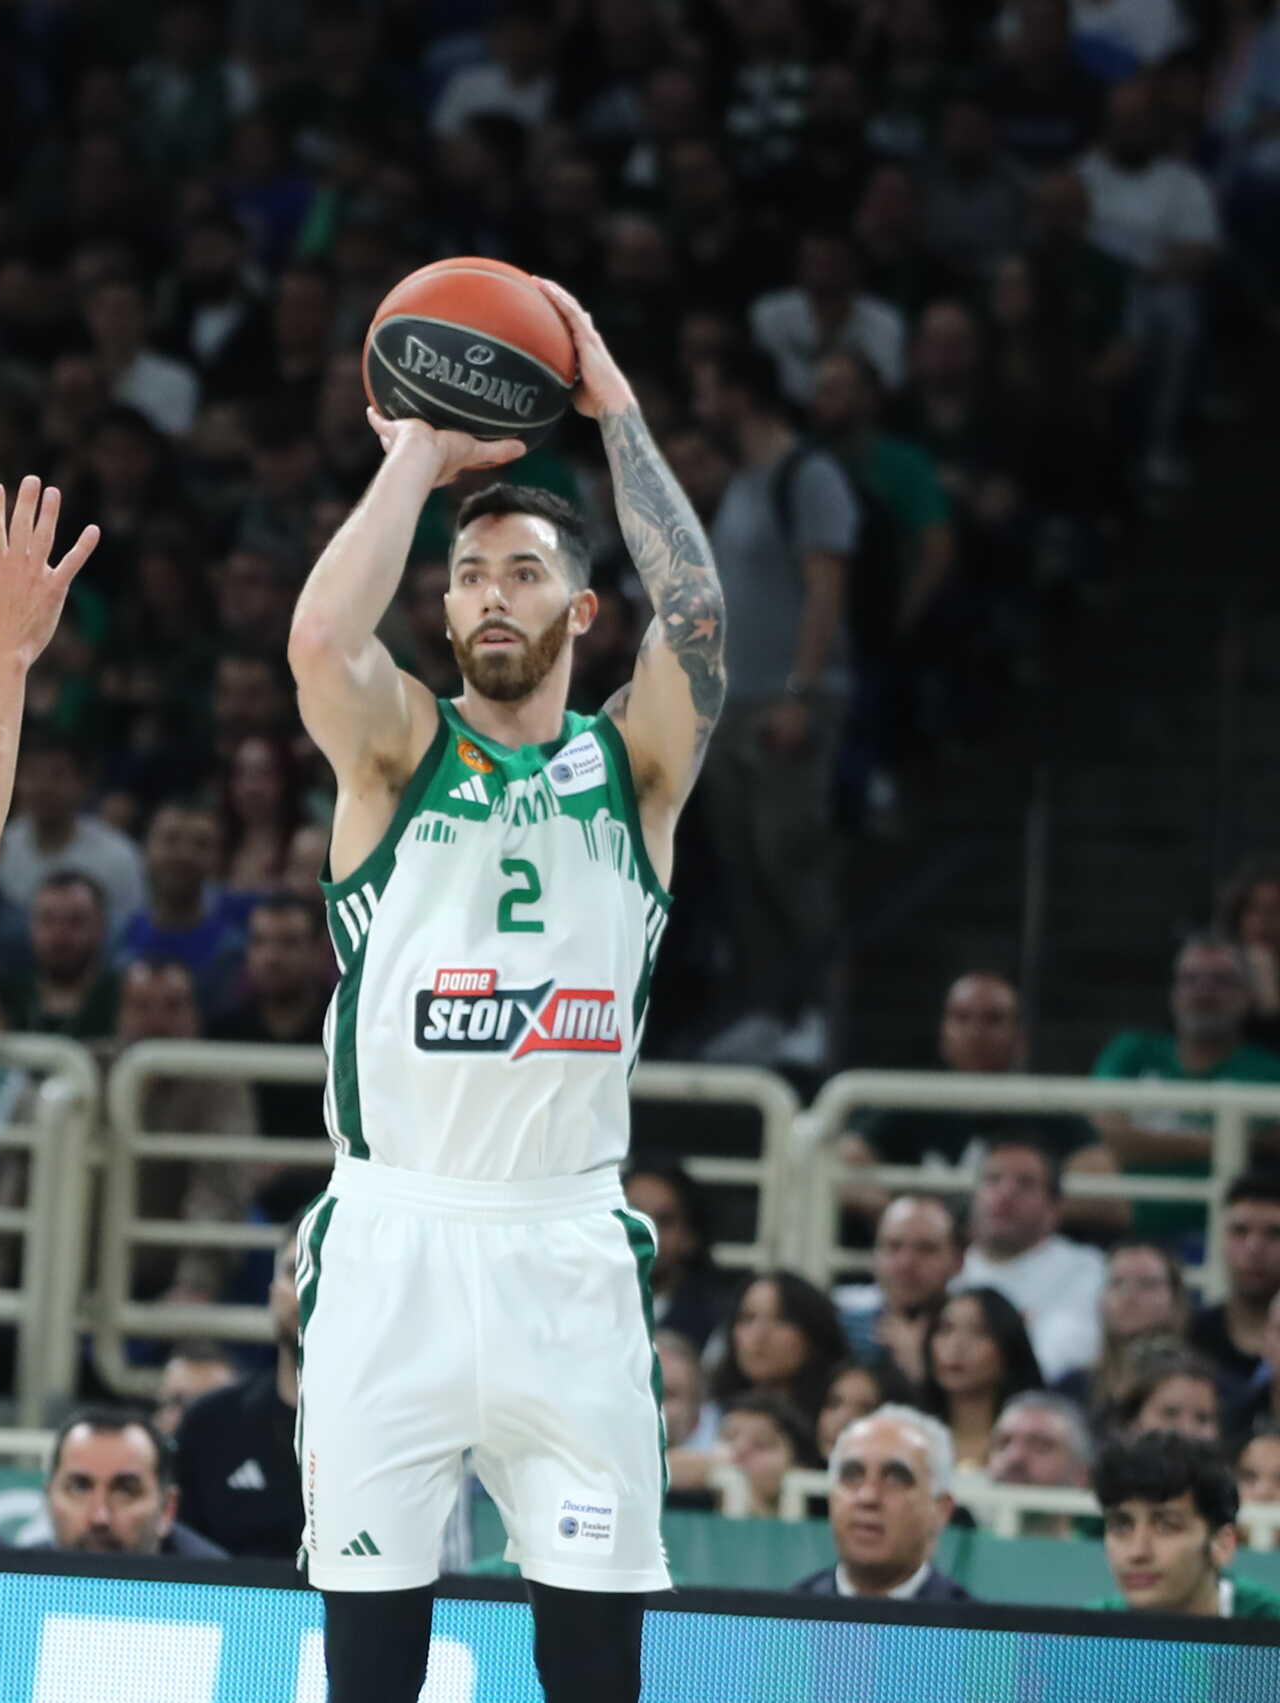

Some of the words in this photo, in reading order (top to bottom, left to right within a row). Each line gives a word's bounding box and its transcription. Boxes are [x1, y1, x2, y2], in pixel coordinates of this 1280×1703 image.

[397, 335, 539, 417] SPALDING
[497, 858, 545, 933] 2
[438, 972, 491, 993] pame
